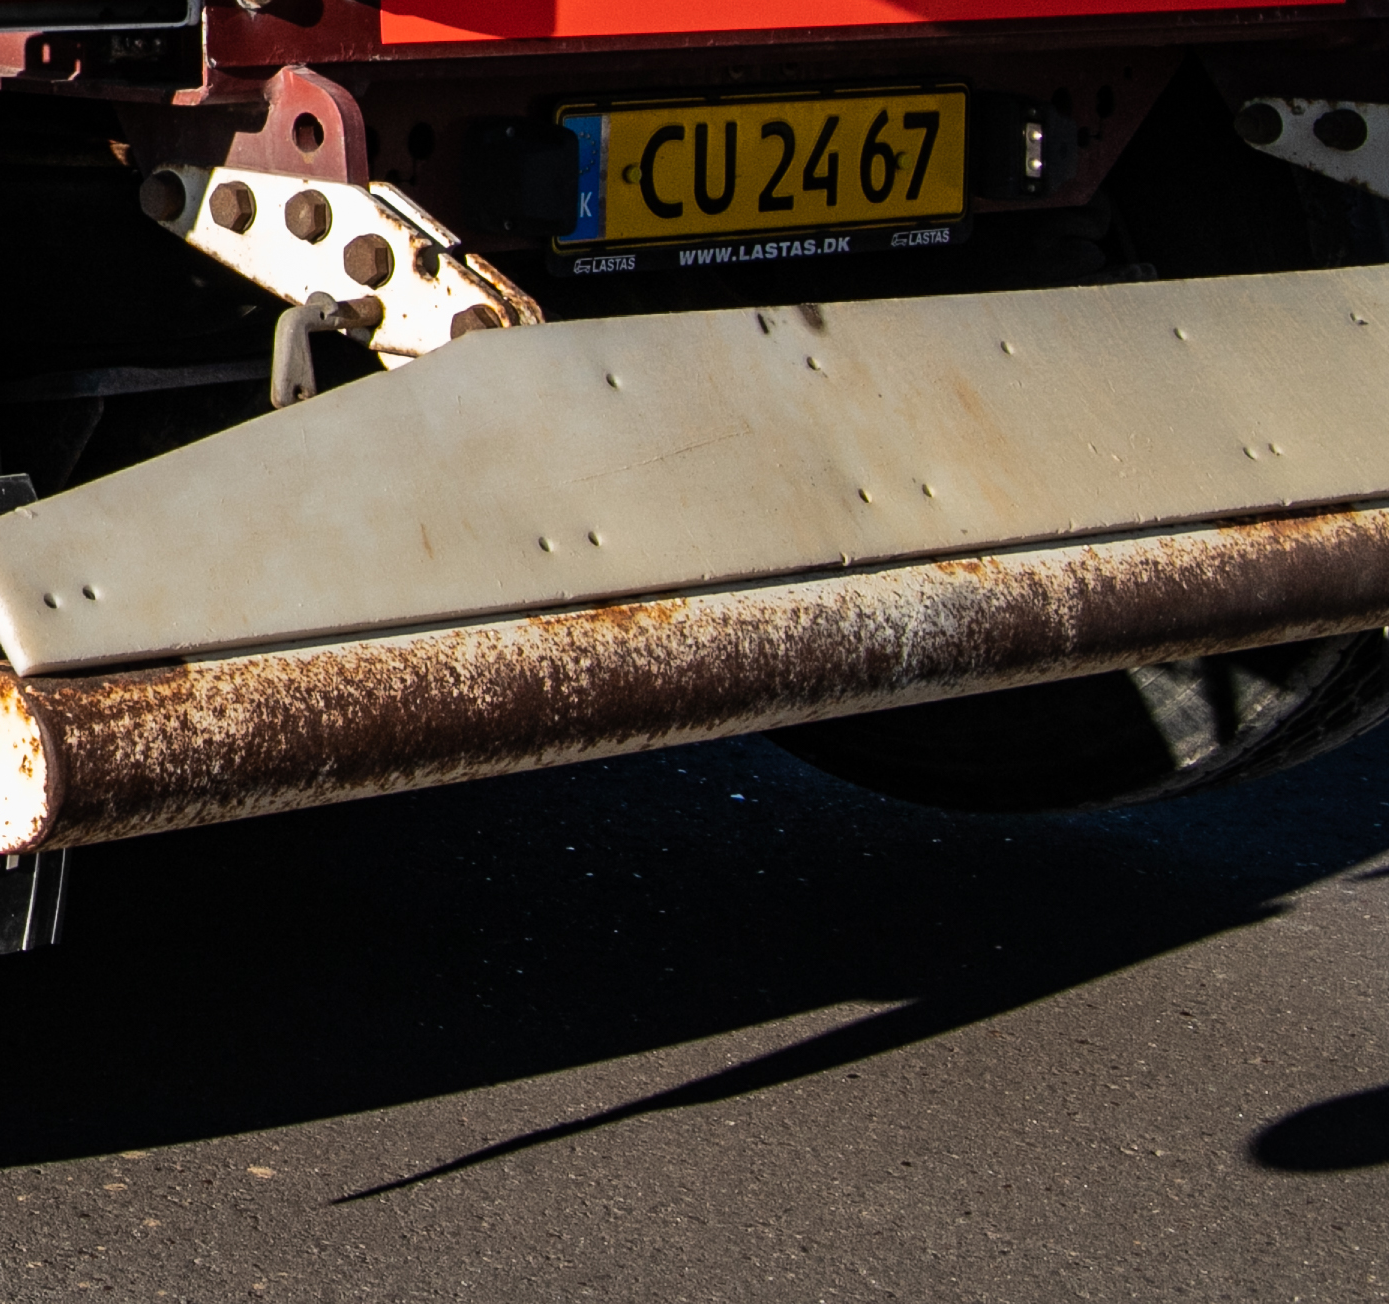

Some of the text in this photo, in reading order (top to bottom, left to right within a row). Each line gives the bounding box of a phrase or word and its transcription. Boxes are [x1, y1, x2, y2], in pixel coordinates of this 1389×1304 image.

[639, 109, 941, 220] CU 24 67
[579, 190, 593, 218] K
[678, 235, 851, 267] WWW.LASTAS.DK
[907, 229, 951, 247] LASTAS
[591, 257, 637, 274] LASTAS
